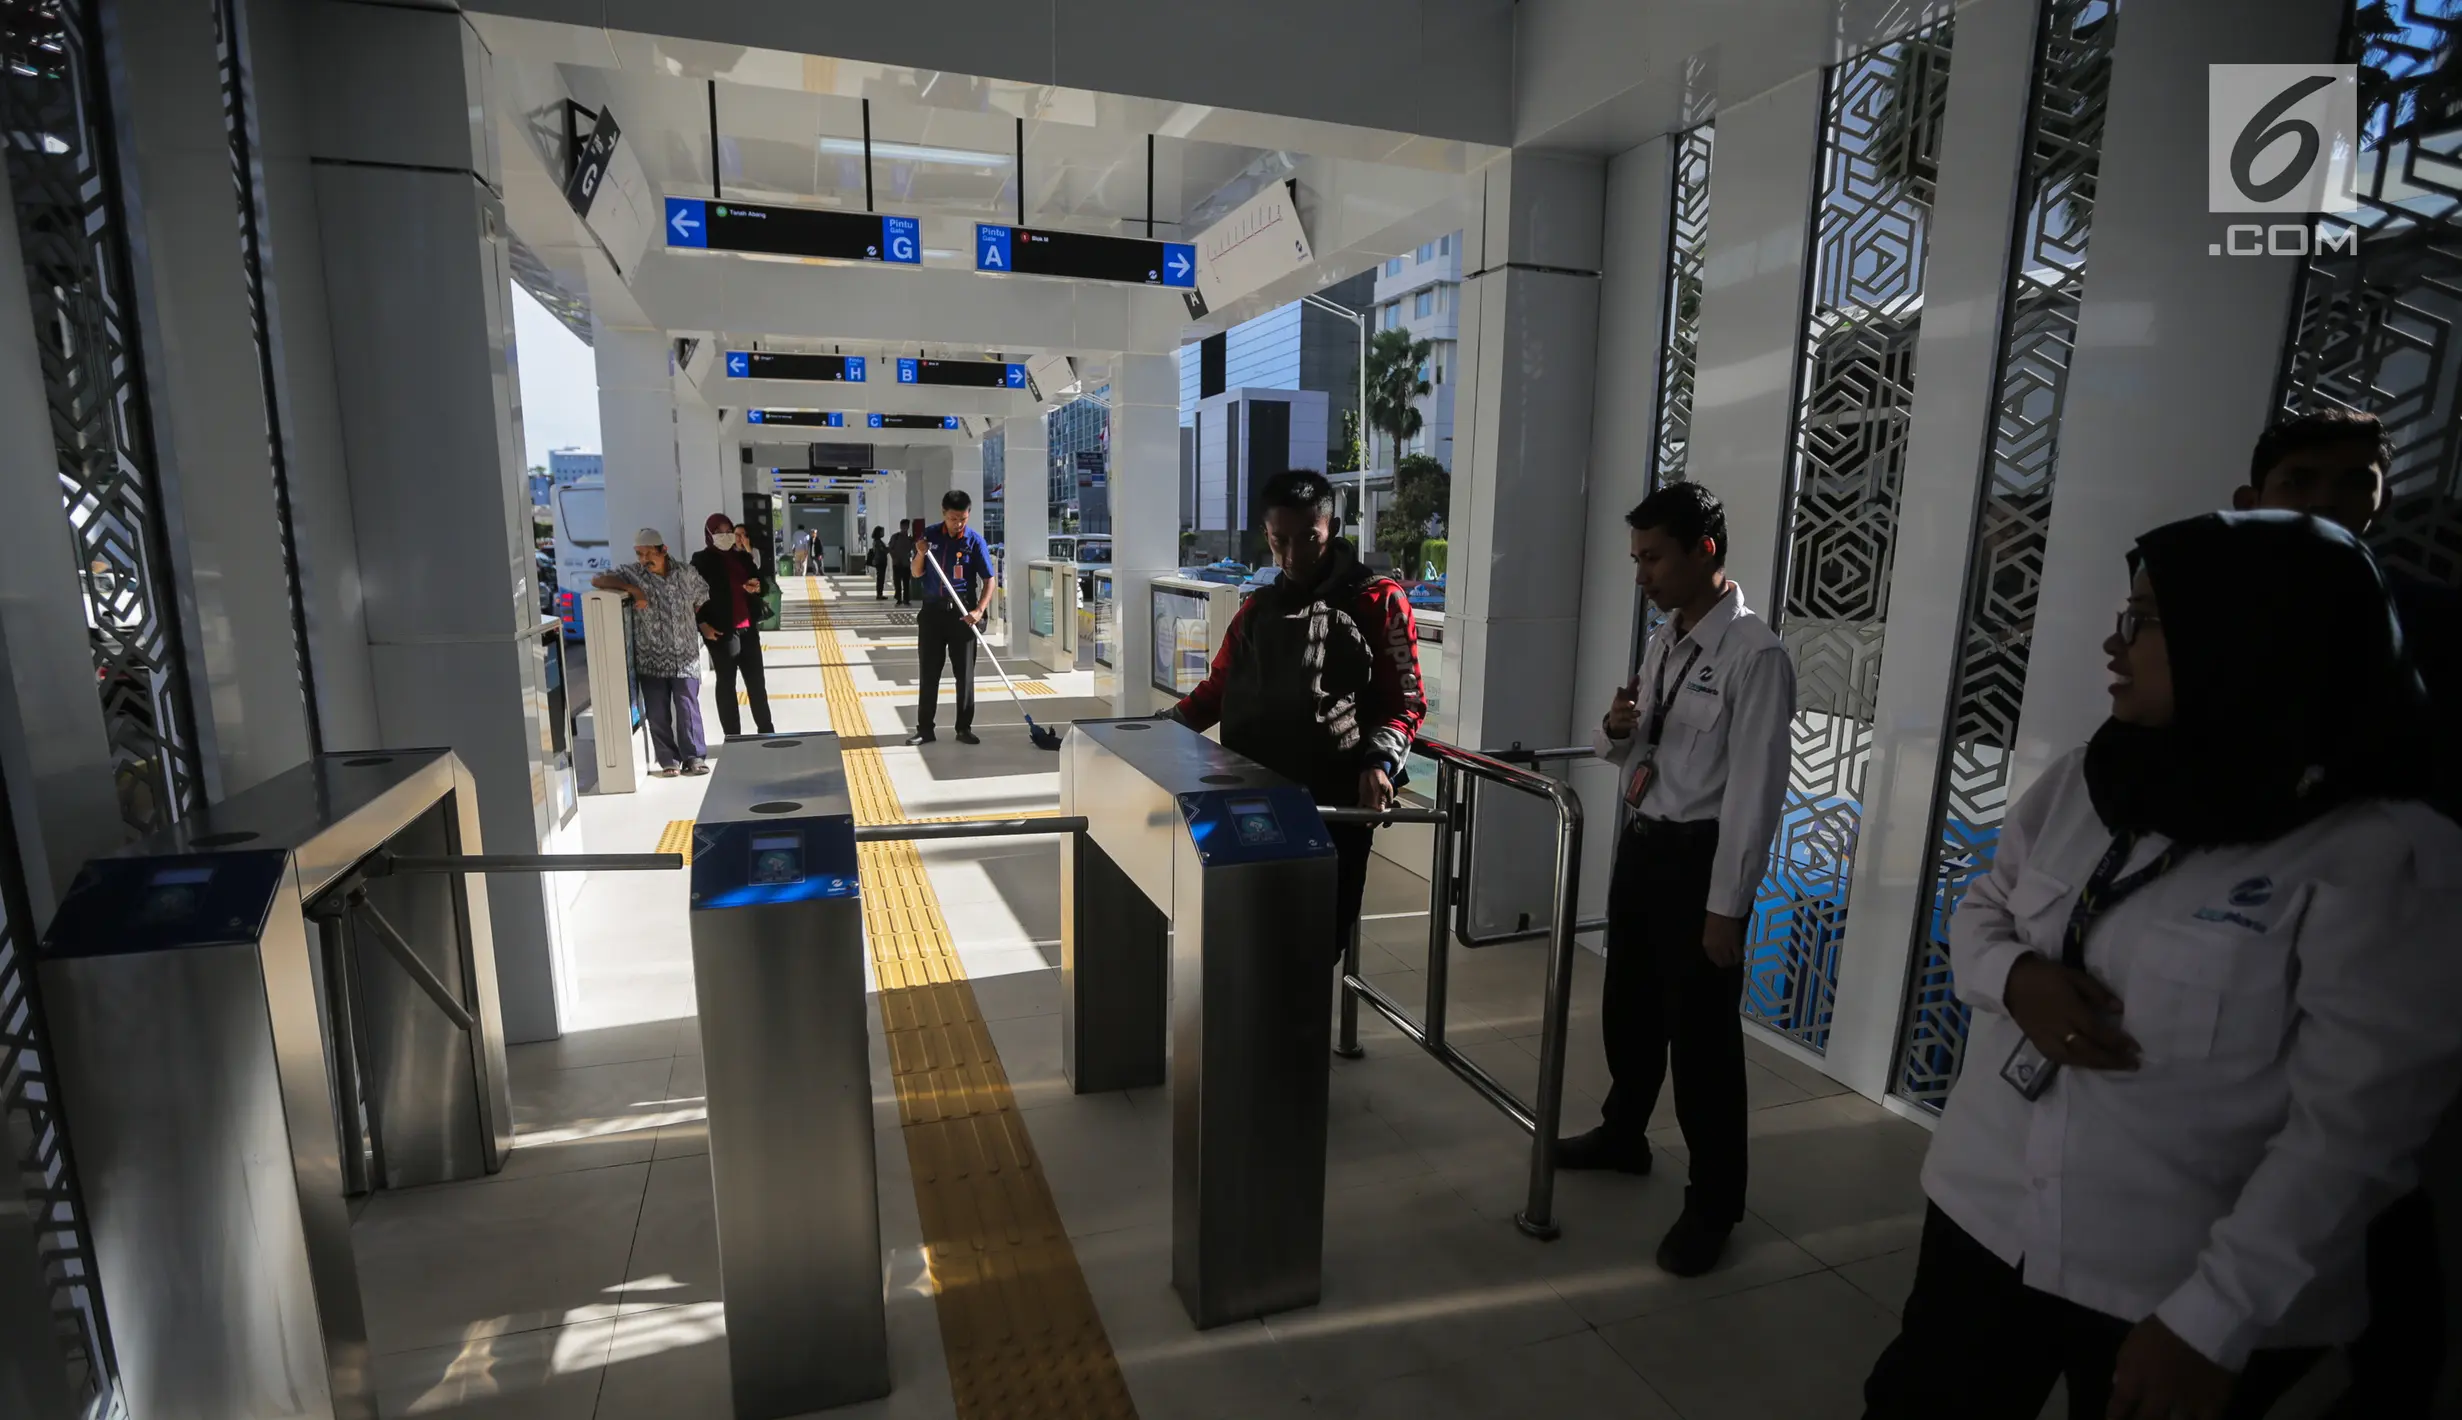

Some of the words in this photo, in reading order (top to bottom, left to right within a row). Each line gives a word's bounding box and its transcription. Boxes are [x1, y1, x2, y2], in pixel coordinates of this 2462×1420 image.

[889, 218, 914, 229] Pintu
[982, 226, 1005, 237] Pintu
[982, 234, 997, 242] Gate
[893, 236, 912, 259] G
[985, 245, 1003, 267] A
[1188, 292, 1200, 307] A
[850, 367, 861, 380] H
[902, 368, 913, 382] B
[870, 417, 879, 427] C
